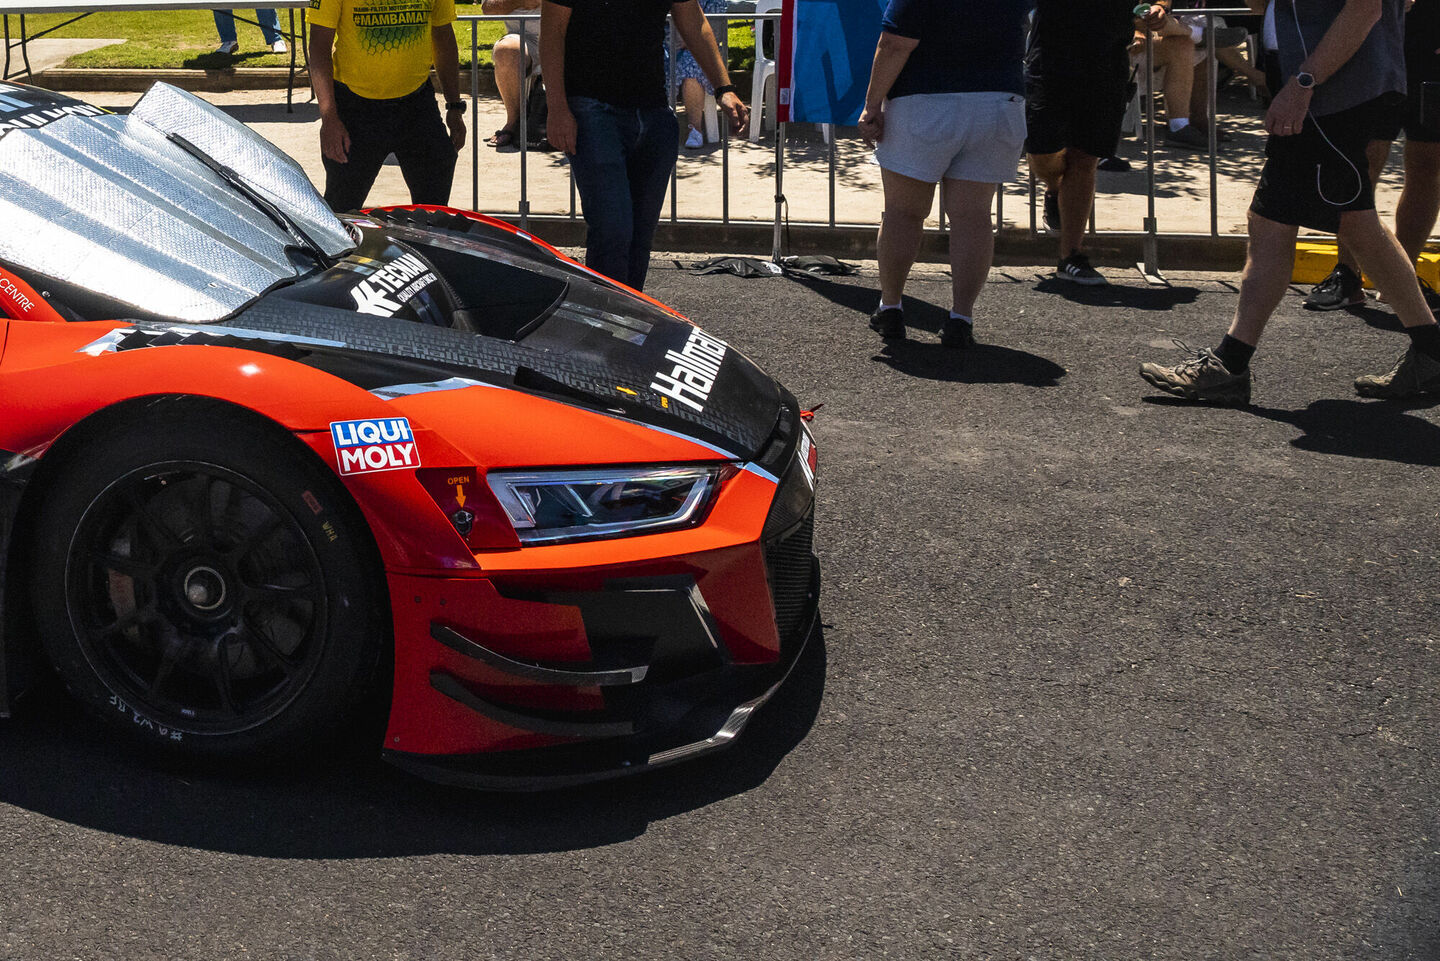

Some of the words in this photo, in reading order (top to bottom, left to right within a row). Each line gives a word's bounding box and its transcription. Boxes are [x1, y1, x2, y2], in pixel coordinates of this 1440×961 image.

[649, 325, 729, 413] Hallmar
[334, 419, 410, 446] LIQUI
[340, 442, 414, 472] MOLY
[447, 476, 470, 485] OPEN
